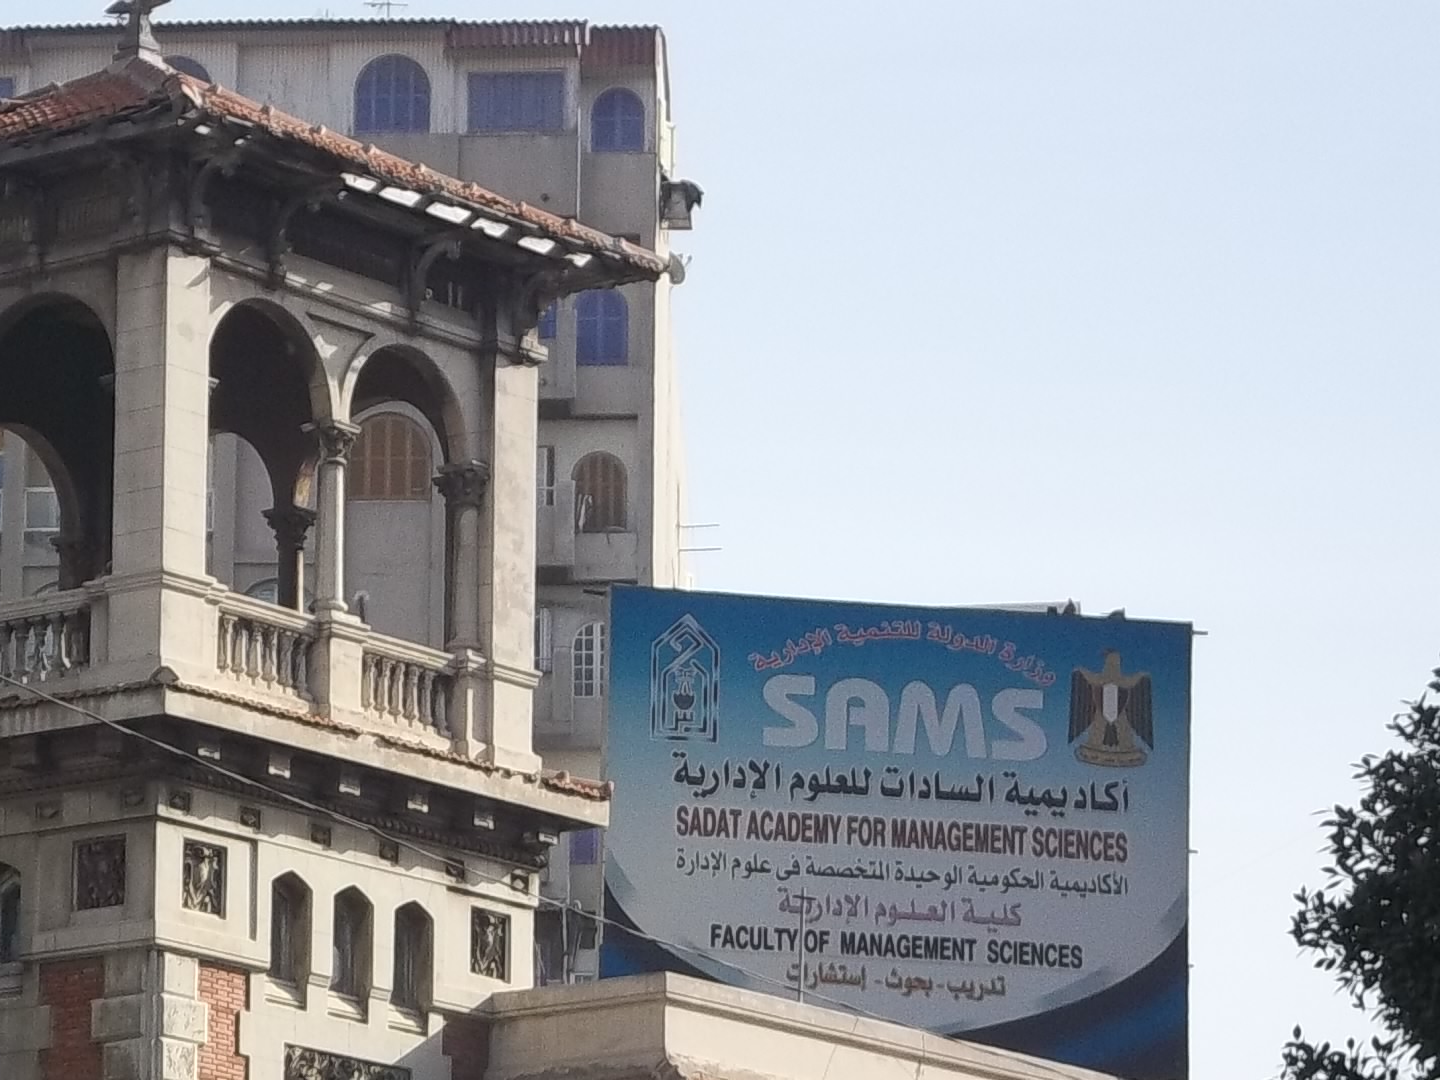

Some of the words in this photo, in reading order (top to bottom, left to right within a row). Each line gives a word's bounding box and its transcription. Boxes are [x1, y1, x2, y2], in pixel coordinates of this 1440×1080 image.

[834, 619, 922, 646] للتنمية
[926, 620, 997, 655] الدولة
[998, 641, 1057, 687] وزارة
[762, 673, 1048, 762] SAMS
[671, 750, 781, 799] الإدارية
[789, 764, 872, 801] للعلوم
[879, 765, 994, 803] السادات
[1002, 770, 1129, 817] أكاديمية
[676, 804, 742, 840] SADAT
[746, 809, 842, 845] ACADEMY
[847, 815, 886, 848] FOR
[891, 817, 1028, 856] MANAGEMENT
[1031, 825, 1129, 864] SCIENCES
[676, 847, 727, 877] الإدارة
[731, 852, 772, 880] علوم
[805, 855, 890, 881] المتخصصة
[893, 860, 962, 891] الوحيدة
[967, 864, 1045, 893] الحكومية
[1049, 870, 1129, 898] الأكاديمية
[710, 923, 799, 953] FACULTY
[803, 929, 831, 954] OF
[839, 930, 978, 962] MANAGEMENT
[986, 938, 1084, 970] SCIENCES
